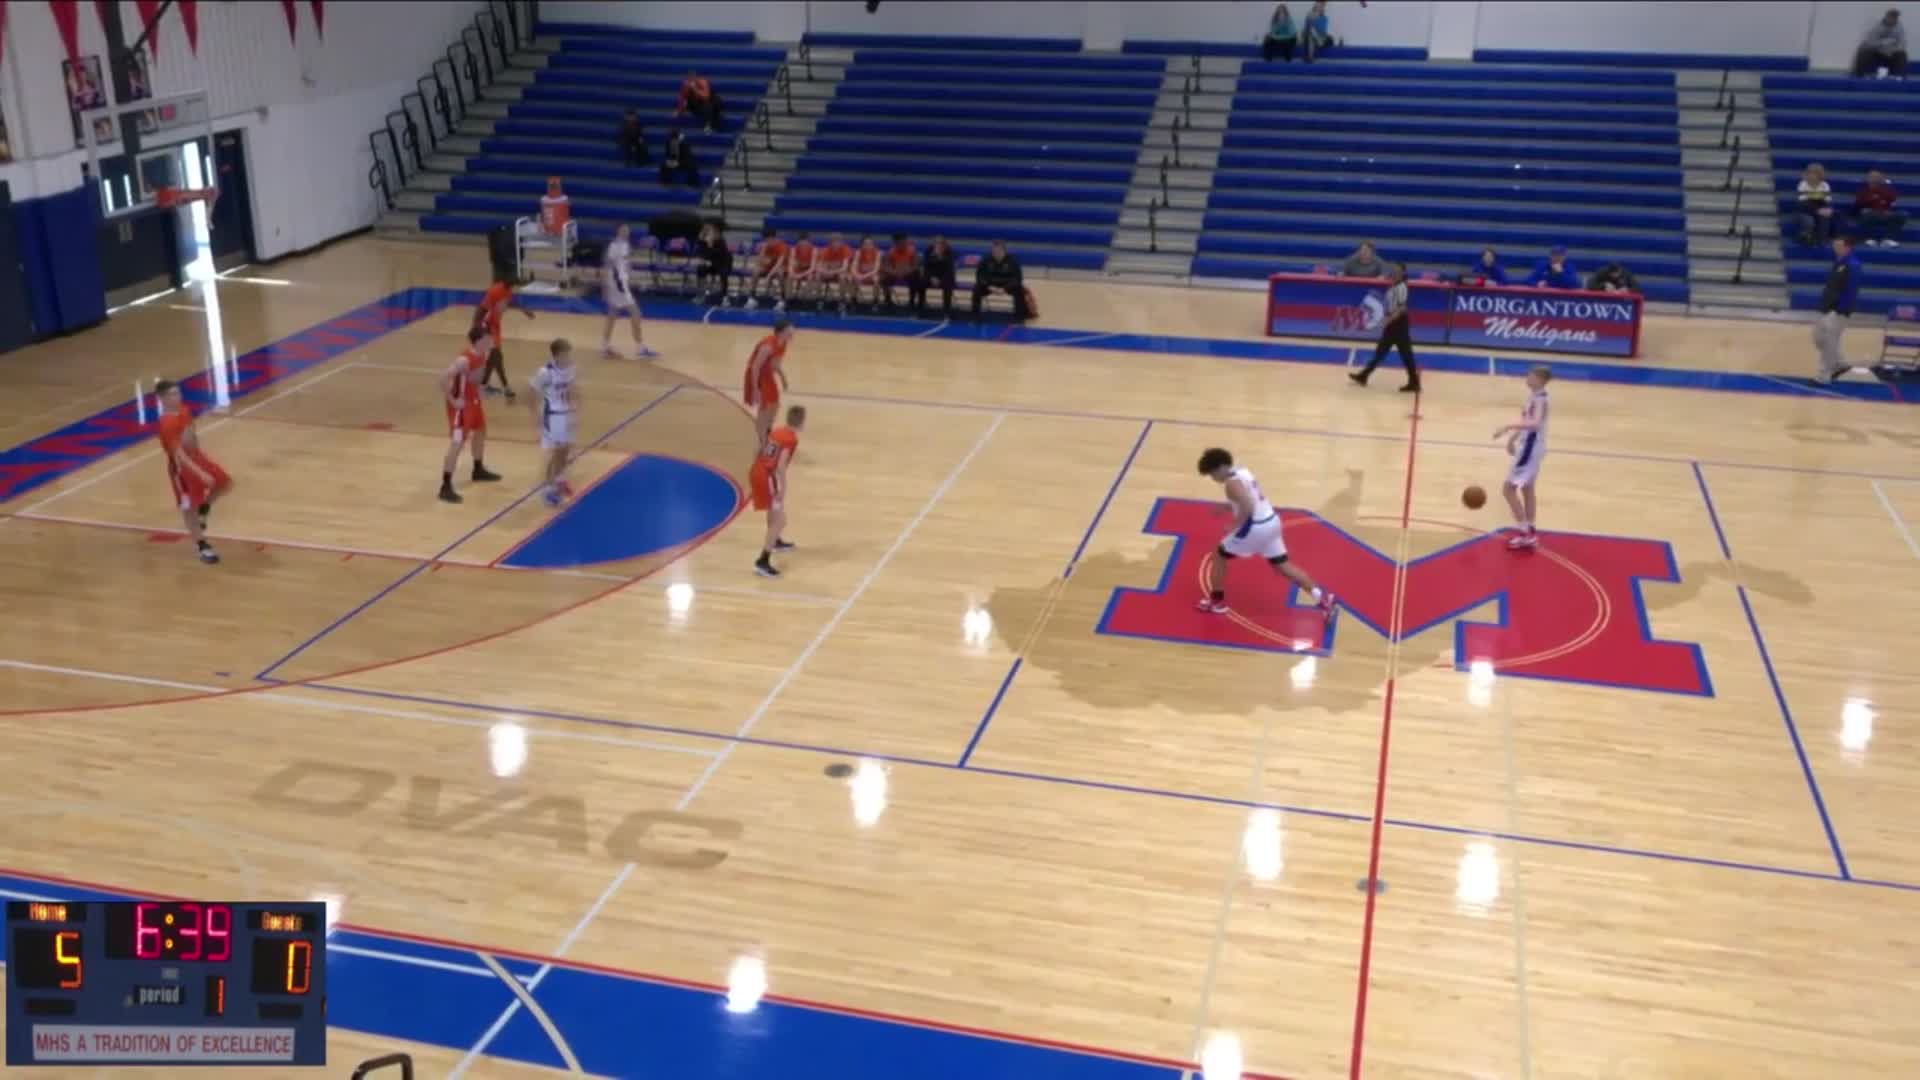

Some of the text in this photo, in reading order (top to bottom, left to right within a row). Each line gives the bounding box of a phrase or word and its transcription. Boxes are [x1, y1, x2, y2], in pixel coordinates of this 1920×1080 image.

[1455, 295, 1633, 321] MORGANTOWN
[1483, 316, 1597, 346] Mohigans
[1094, 496, 1715, 698] M
